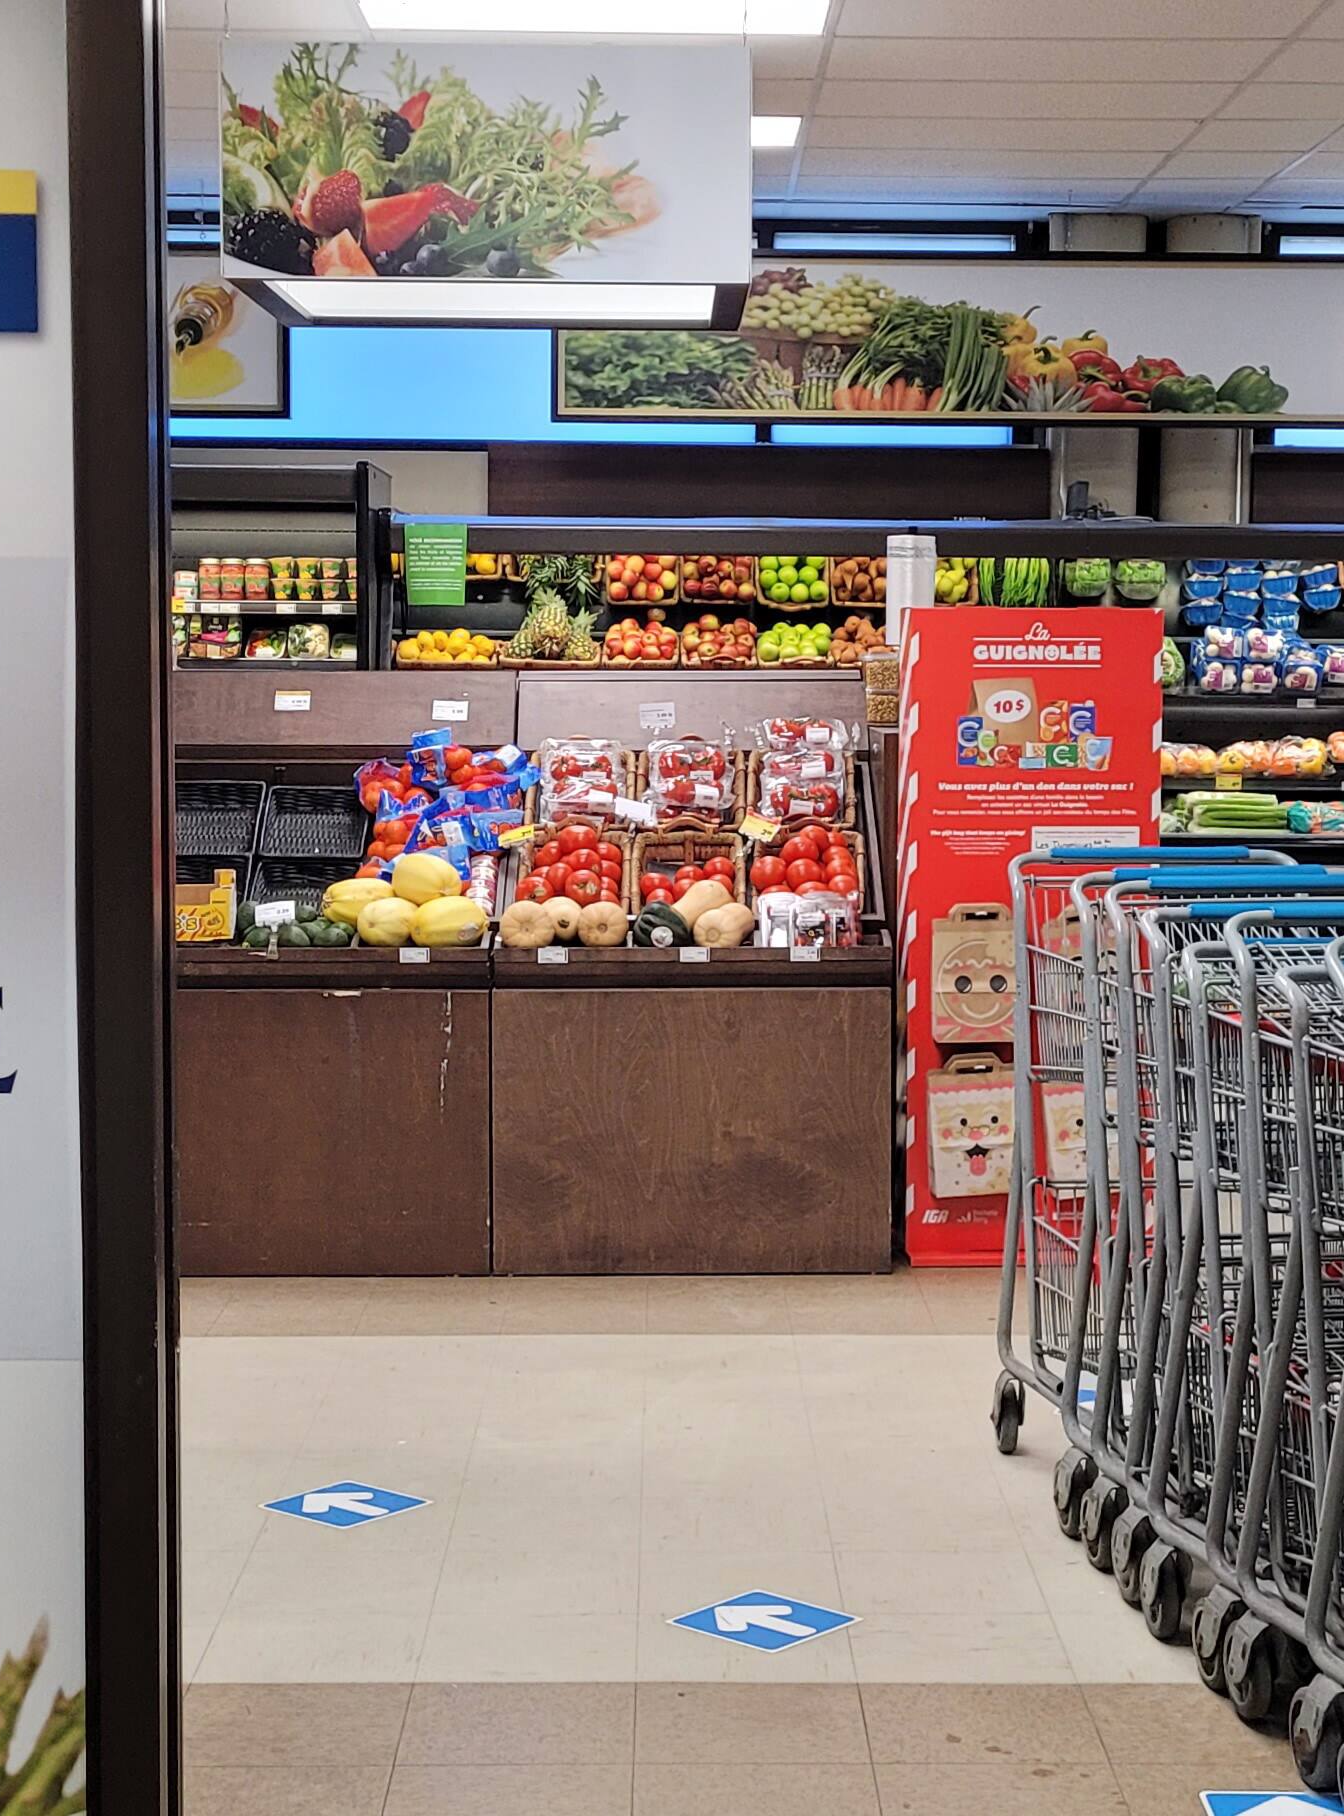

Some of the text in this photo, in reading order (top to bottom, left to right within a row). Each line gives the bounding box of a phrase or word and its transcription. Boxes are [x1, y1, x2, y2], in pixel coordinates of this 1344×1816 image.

[1024, 621, 1051, 642] La
[972, 641, 1103, 662] GUIGNOLÉE
[993, 700, 1013, 714] 10
[938, 782, 963, 791] Vous
[963, 783, 987, 791] avez
[988, 781, 1011, 792] plus
[1012, 781, 1035, 791] d'un
[1035, 782, 1056, 791] don
[1056, 782, 1082, 791] dans
[1082, 782, 1109, 791] votre
[1110, 783, 1128, 791] sac
